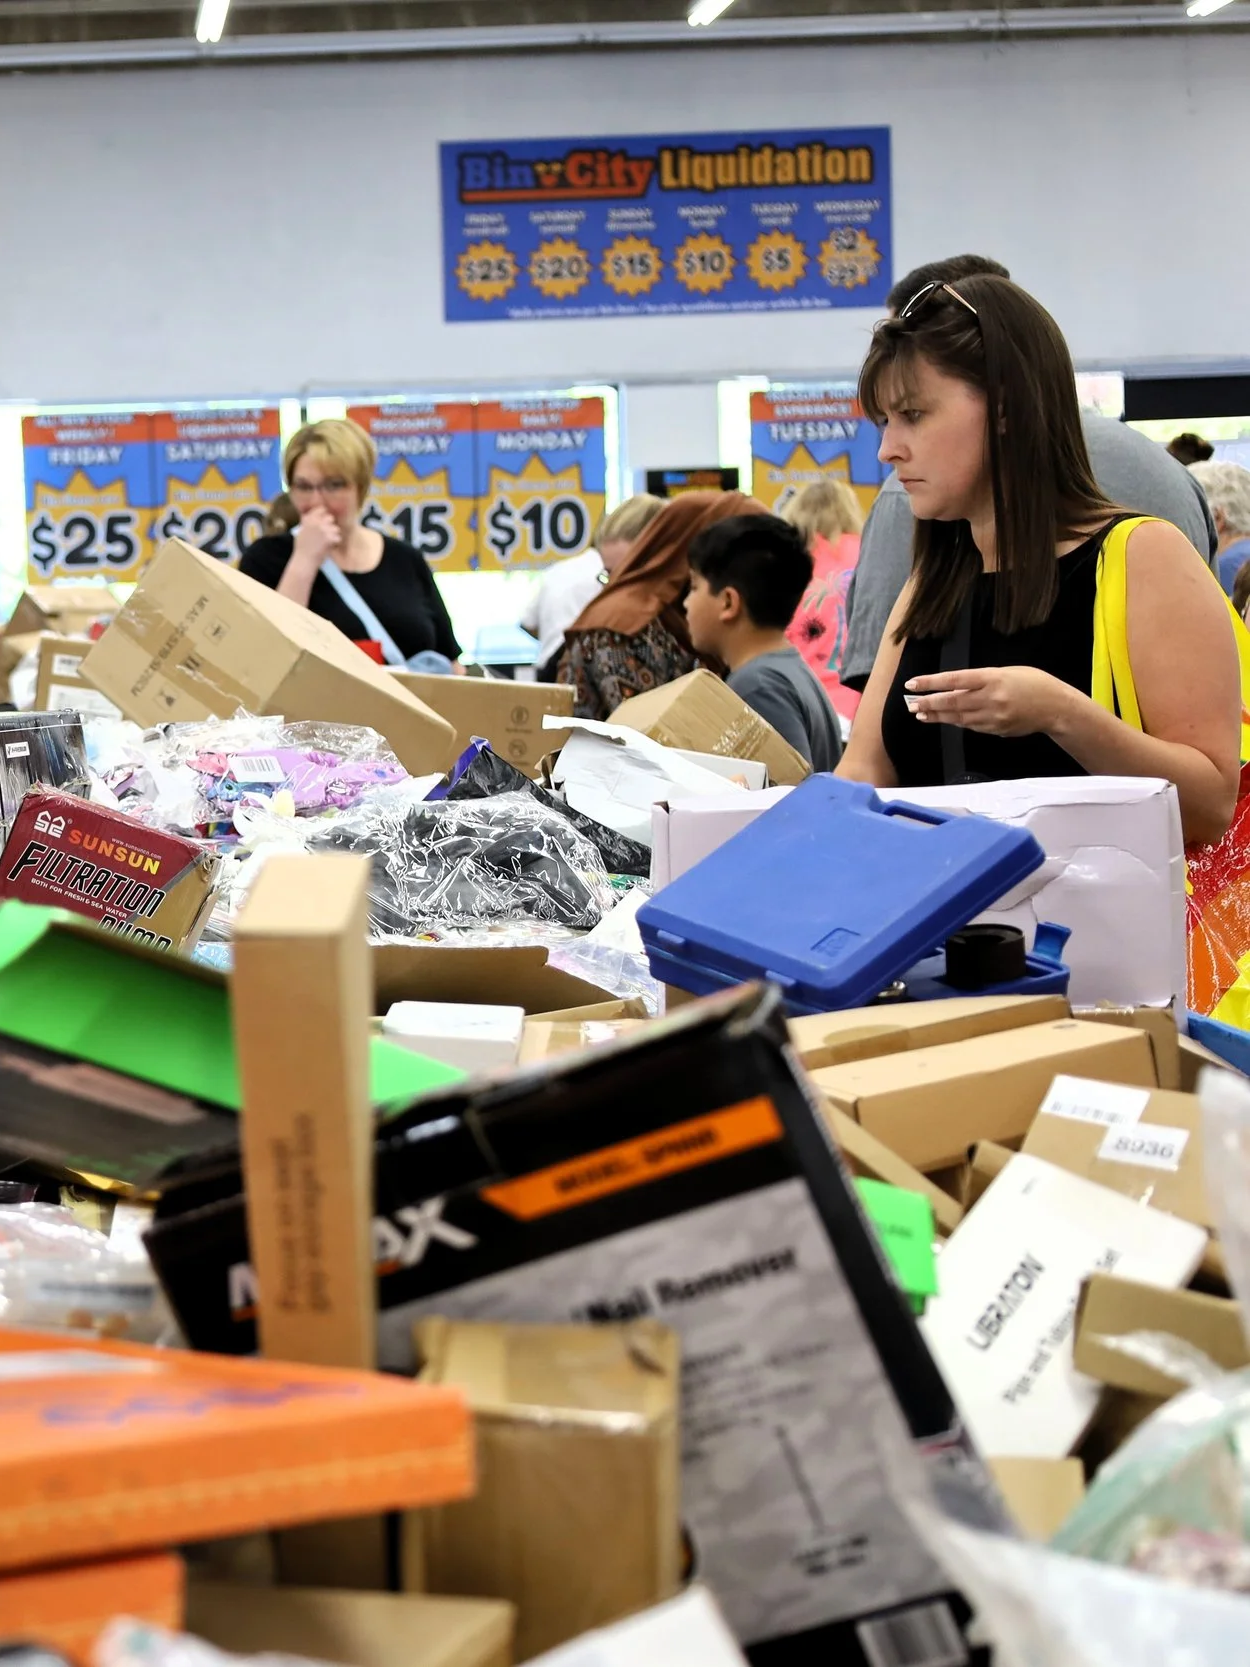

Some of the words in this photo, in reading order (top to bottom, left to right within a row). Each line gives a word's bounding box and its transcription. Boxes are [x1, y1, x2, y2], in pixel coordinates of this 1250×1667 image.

[462, 155, 534, 189] Bin
[565, 150, 655, 189] City
[660, 144, 873, 191] Liquidation
[464, 258, 511, 282] $25
[535, 255, 584, 280] $20
[612, 251, 651, 279] $15
[683, 250, 726, 276] $10
[762, 246, 791, 273] $5
[496, 430, 588, 451] MONDAY
[768, 420, 859, 443] TUESDAY
[49, 447, 123, 466] FRIDAY
[165, 441, 273, 462] SATURDAY
[490, 500, 586, 557] $10
[32, 515, 135, 571] $25
[68, 828, 161, 876] SUNSUN
[7, 840, 166, 919] FILTRATION
[30, 877, 49, 891] BOTH
[49, 884, 63, 896] FOR
[64, 889, 86, 904] FRESH
[91, 899, 104, 911] SEA
[105, 905, 127, 919] WATER
[1114, 1138, 1175, 1160] 8936
[655, 1249, 797, 1306] Remover
[967, 1252, 1045, 1352] LIBRATON
